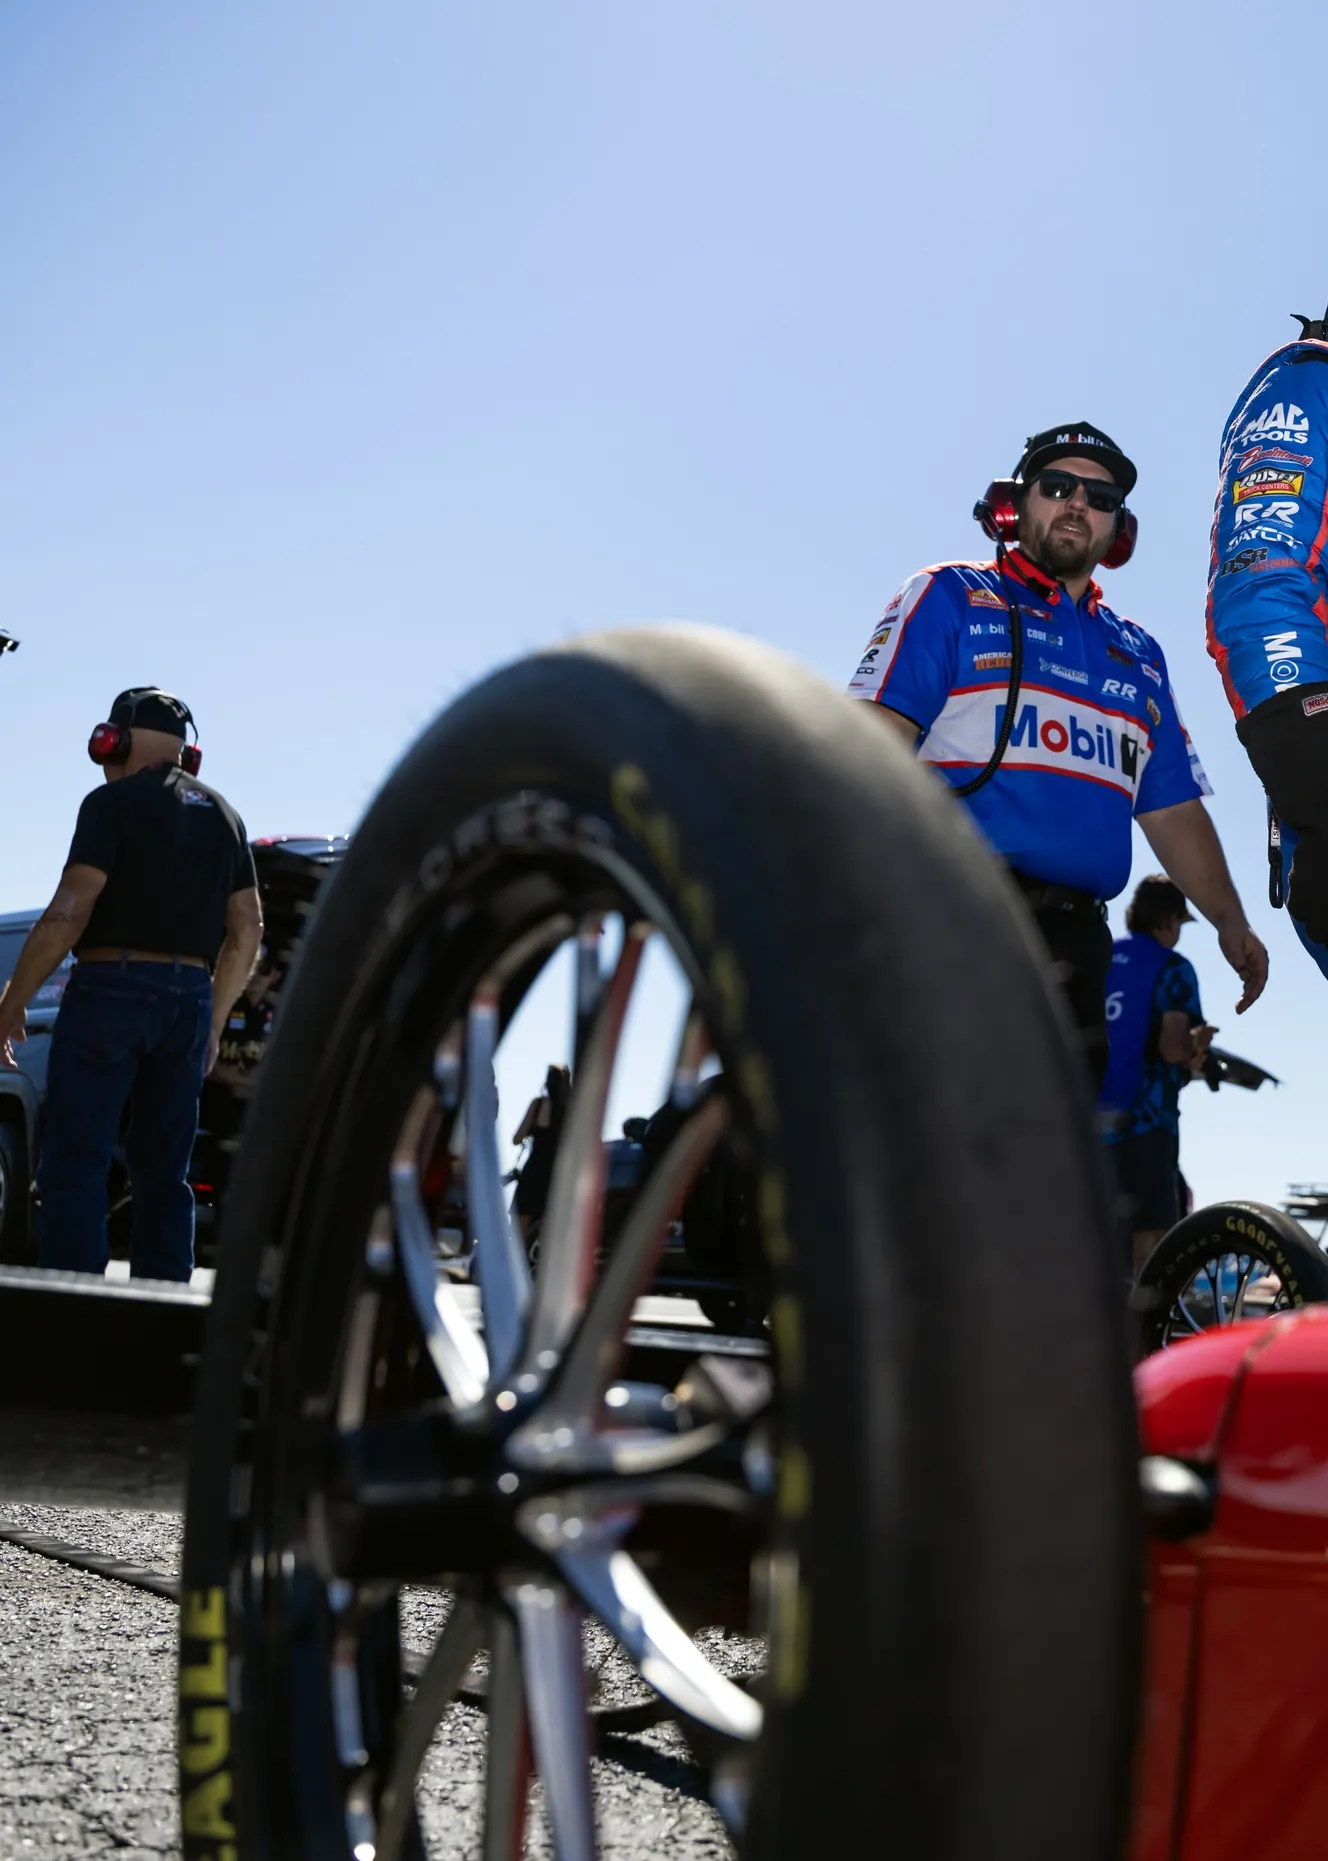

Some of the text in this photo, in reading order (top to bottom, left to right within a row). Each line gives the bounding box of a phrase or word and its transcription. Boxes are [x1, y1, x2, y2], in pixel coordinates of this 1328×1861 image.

[1241, 402, 1309, 438] MAC
[1056, 433, 1095, 446] Mobil
[1241, 430, 1308, 447] TOOLS
[1261, 482, 1290, 490] CENTERS
[1233, 502, 1300, 531] RR
[1221, 547, 1270, 578] DSR
[973, 652, 1013, 662] AMERICA
[1102, 679, 1138, 700] RR
[995, 704, 1115, 770] Mobil
